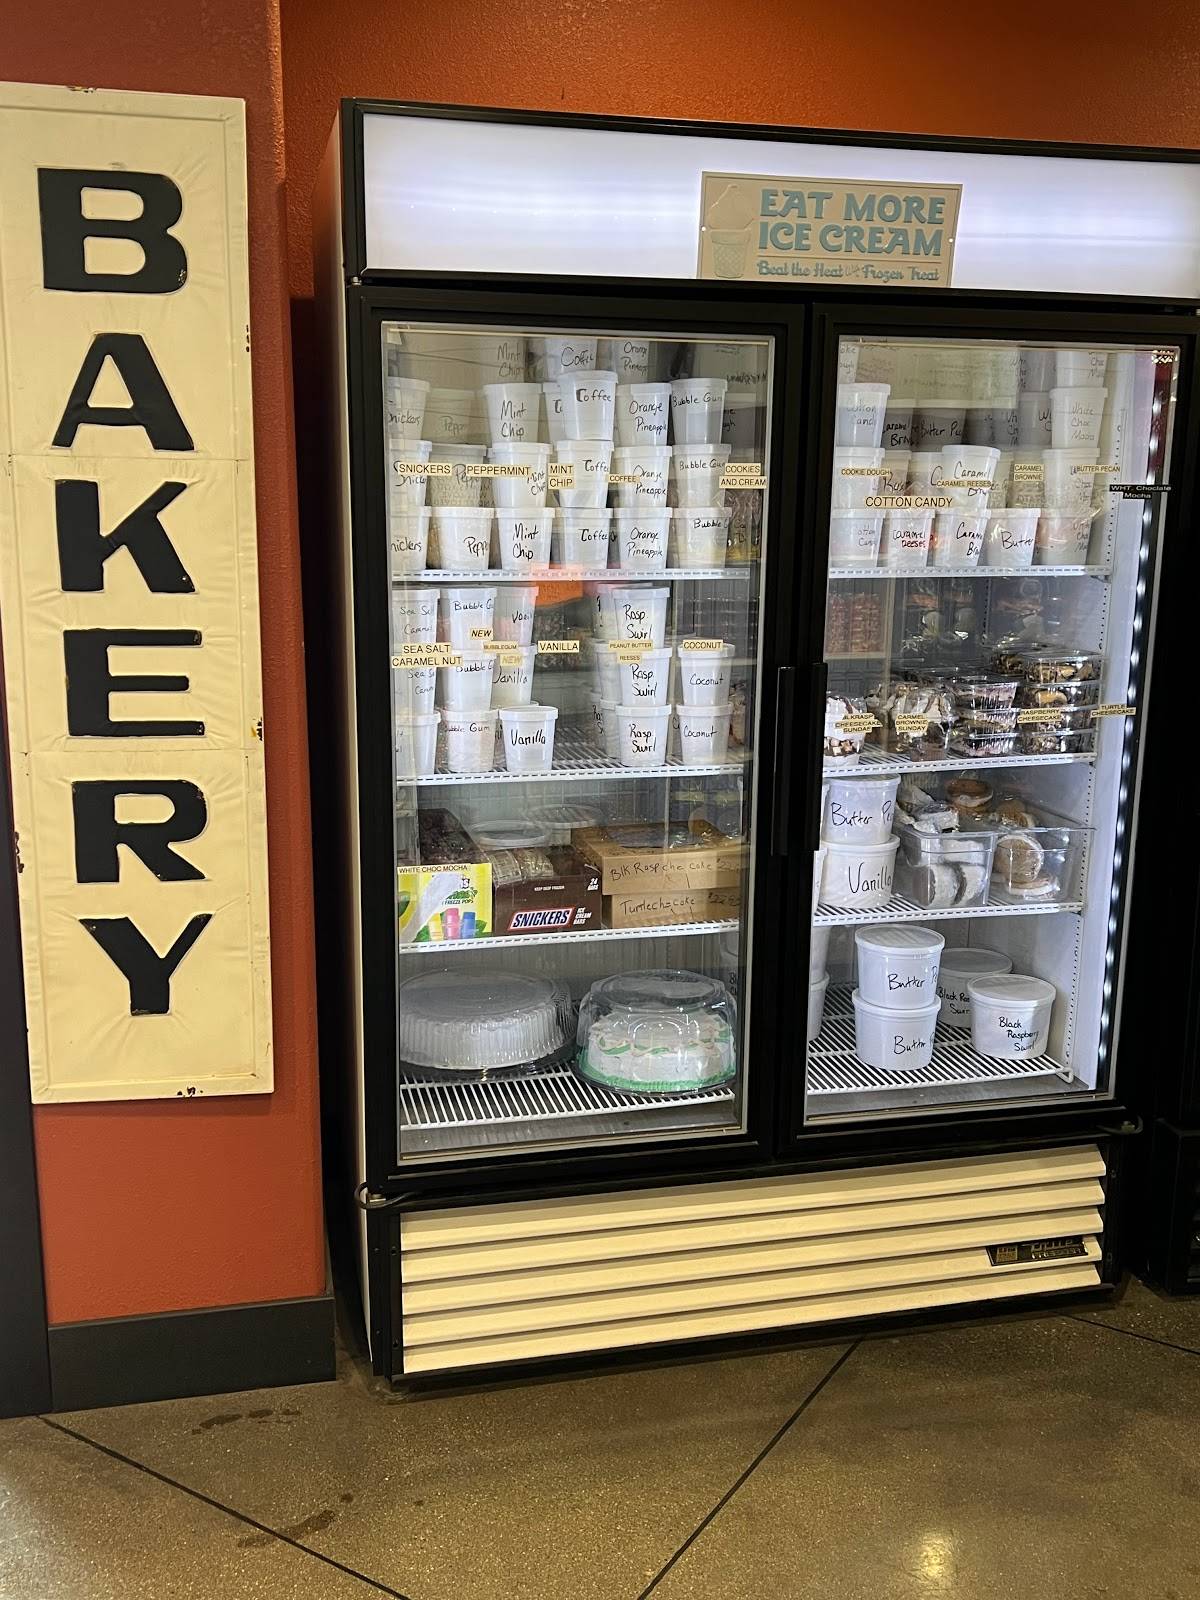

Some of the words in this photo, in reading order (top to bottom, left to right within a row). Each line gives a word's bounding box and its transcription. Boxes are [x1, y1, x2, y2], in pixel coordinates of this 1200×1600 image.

[758, 187, 834, 219] EAT
[842, 192, 946, 224] MORE
[758, 221, 812, 251] ICE
[818, 223, 943, 256] CREAM
[757, 260, 789, 277] Beat
[790, 260, 809, 276] the
[812, 262, 844, 278] Heat
[862, 264, 904, 283] Frozen
[907, 266, 940, 281] Treat
[500, 399, 527, 421] Mint
[628, 400, 663, 416] Orange
[500, 422, 525, 443] Chip
[398, 463, 452, 475] SNICKERS
[466, 464, 532, 476] PEPPERMINT
[549, 465, 574, 475] MINT
[679, 460, 708, 471] Bubble
[725, 464, 761, 474] COOKIES
[1014, 465, 1044, 473] CARAMEL
[1076, 465, 1100, 473] BUTTER
[1100, 465, 1121, 473] PECAN
[841, 468, 866, 476] COOKIE
[866, 468, 890, 477] DOUGH
[1014, 473, 1043, 481] BROWNIE
[549, 478, 573, 488] CHIP
[609, 474, 637, 483] COFFEE
[720, 477, 738, 487] AND
[738, 477, 767, 487] CREAM
[936, 480, 966, 488] CARAMEL
[966, 480, 992, 488] REESES
[1135, 484, 1172, 492] Choclate
[865, 496, 912, 507] COTTON
[914, 497, 953, 507] CANDY
[512, 522, 540, 542] Mint
[512, 542, 534, 562] Chip
[37, 167, 212, 1016] BAKERY
[471, 629, 492, 638] NEW
[626, 623, 653, 640] Swirl
[403, 645, 424, 654] SEA
[425, 644, 451, 653] SALT
[539, 642, 579, 652] VANILLA
[609, 642, 630, 650] PEANUT
[683, 641, 722, 650] COCONUT
[392, 657, 440, 667] CARAMEL
[442, 656, 462, 666] NUT
[502, 656, 521, 664] NEW
[689, 672, 724, 686] Coconut
[632, 682, 658, 698] Swirl
[1091, 708, 1135, 717] CHEESECAKE
[1017, 715, 1062, 723] CHEESECAKE
[469, 722, 490, 733] Gum
[683, 725, 718, 738] Coconut
[510, 729, 546, 747] Vanilla
[632, 739, 657, 754] Swirl
[830, 802, 873, 827] Butter
[398, 867, 421, 875] WHITE
[848, 861, 893, 895] Vanilla
[512, 909, 570, 928] SNICKERS
[888, 973, 926, 991] Butter
[998, 1016, 1022, 1028] Black
